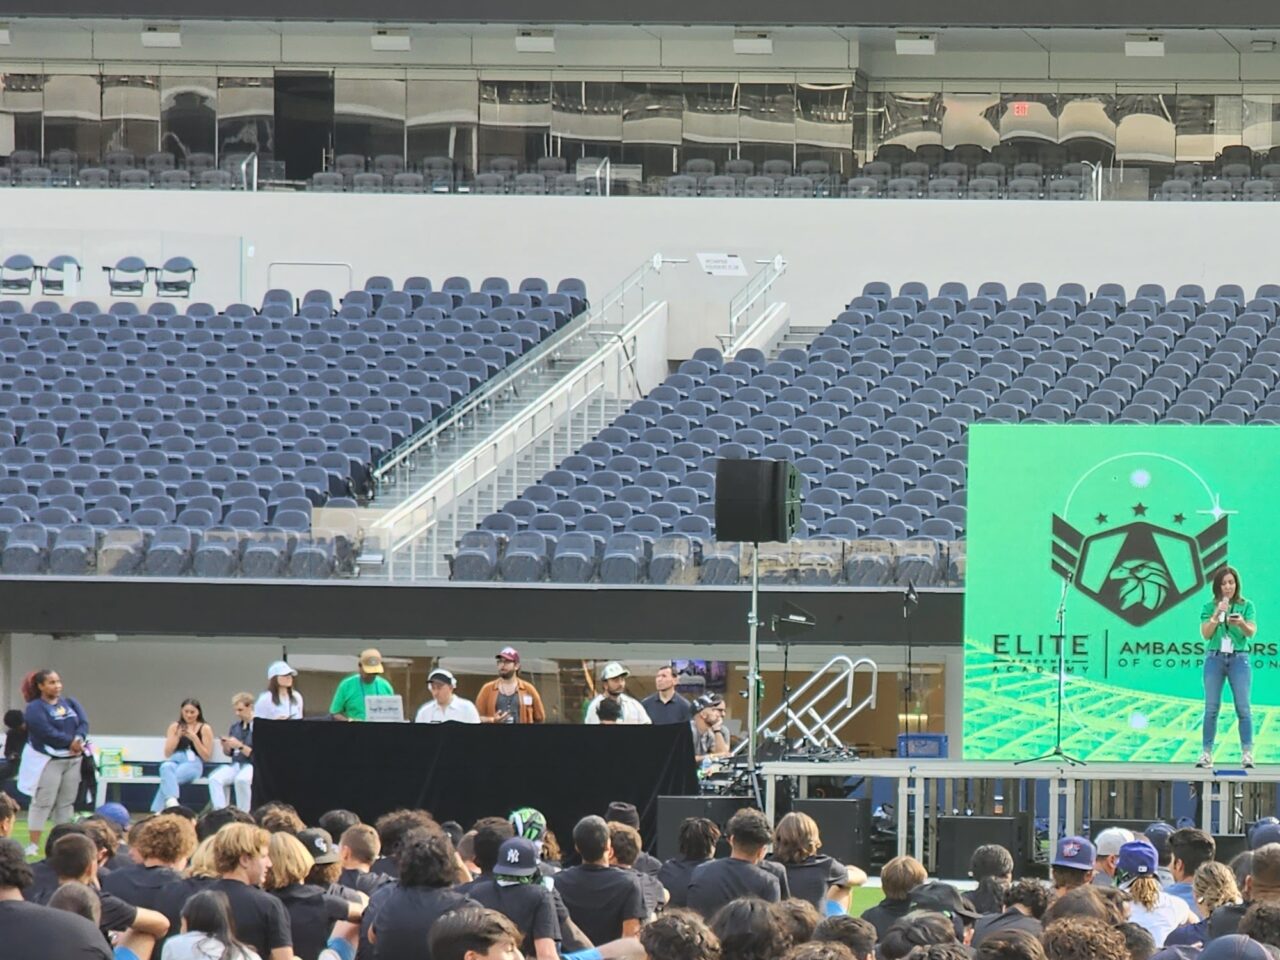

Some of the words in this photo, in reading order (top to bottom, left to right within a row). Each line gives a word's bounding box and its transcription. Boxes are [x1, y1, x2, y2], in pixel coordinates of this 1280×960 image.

[993, 634, 1088, 655] ELITE
[1120, 642, 1279, 656] AMBASSRS
[1118, 658, 1140, 667] OF
[1153, 659, 1279, 669] COMPON
